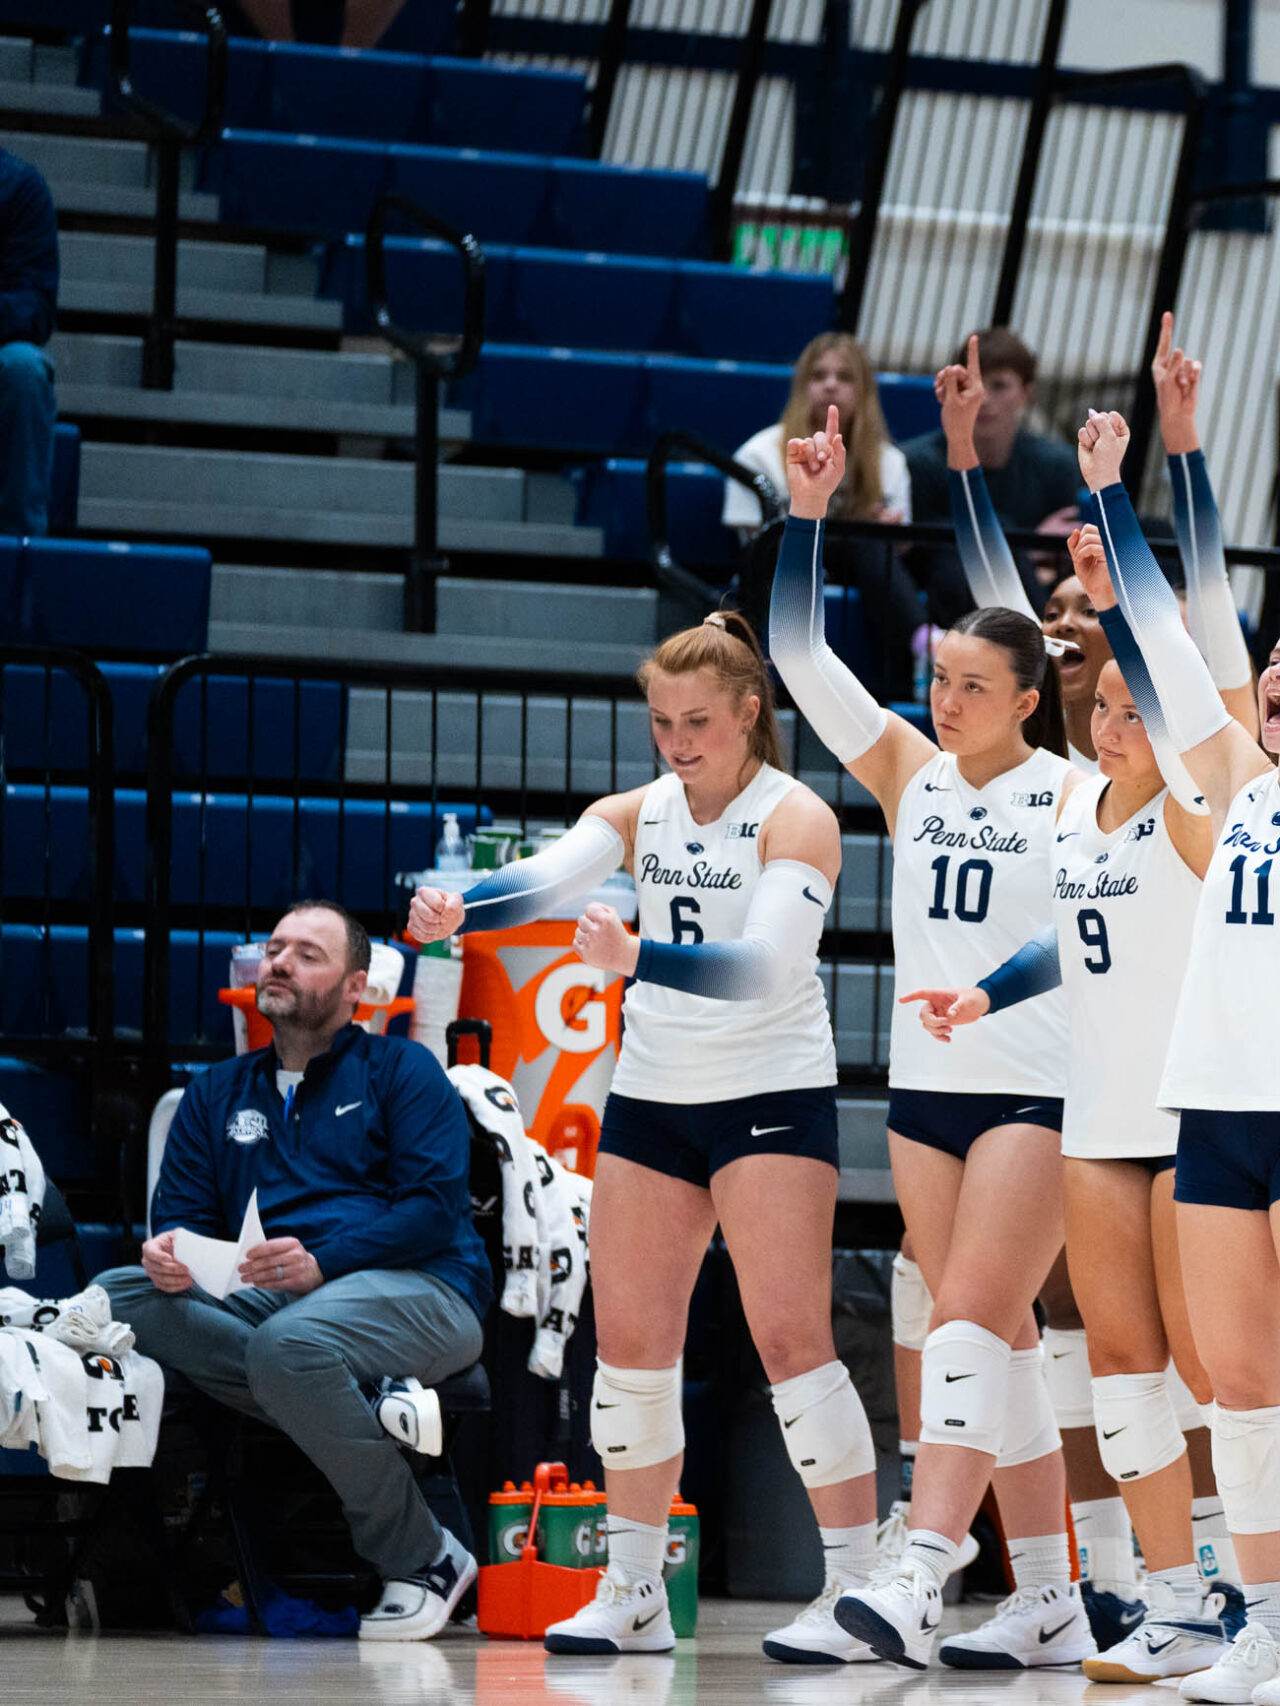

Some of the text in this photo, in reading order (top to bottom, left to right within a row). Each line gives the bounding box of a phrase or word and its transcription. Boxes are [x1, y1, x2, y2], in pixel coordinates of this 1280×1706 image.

[913, 815, 1029, 854] Penn State
[640, 853, 743, 890] Penn State
[928, 854, 994, 924] 10
[1053, 867, 1139, 900] Penn State
[1225, 854, 1275, 926] 11
[669, 895, 704, 945] 6
[1077, 908, 1112, 975] 9
[534, 962, 607, 1054] G
